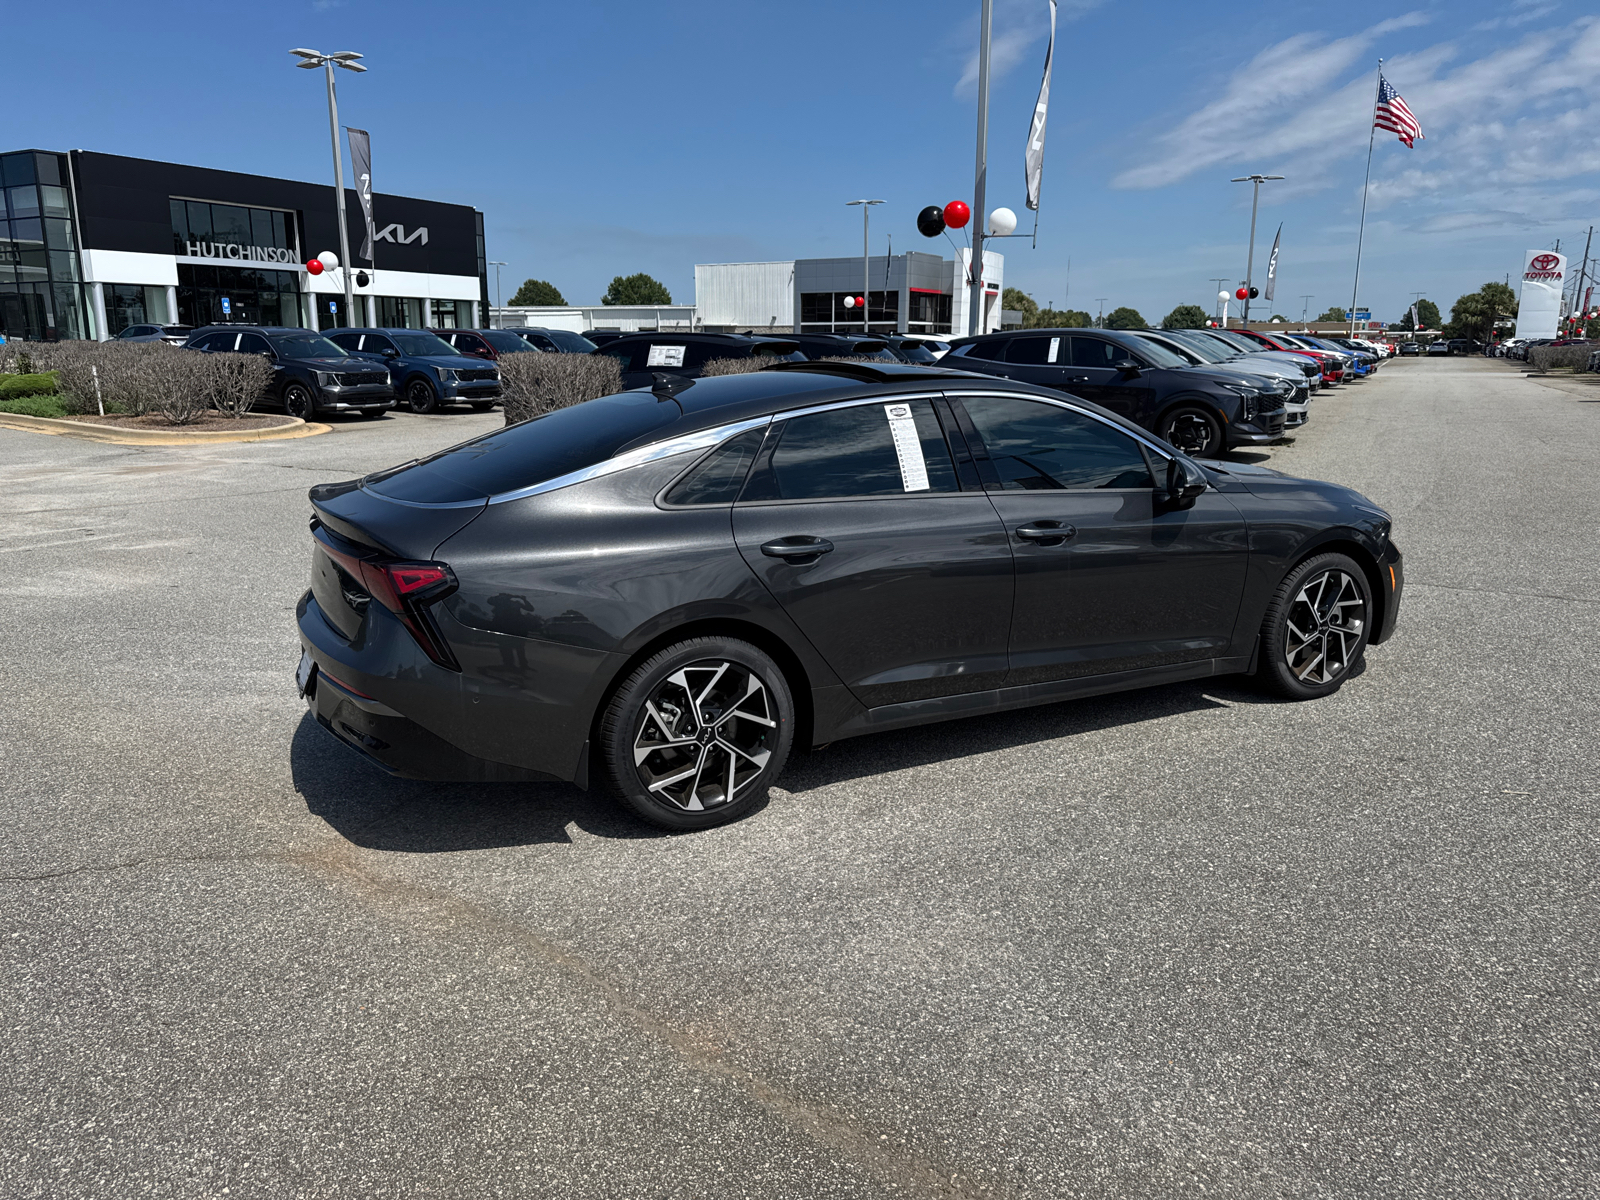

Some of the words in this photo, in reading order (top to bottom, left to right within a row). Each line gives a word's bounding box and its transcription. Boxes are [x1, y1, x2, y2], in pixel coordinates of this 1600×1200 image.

[372, 221, 429, 246] KIA
[186, 241, 301, 264] HUTCHINSON
[1525, 271, 1563, 280] TOYOTA
